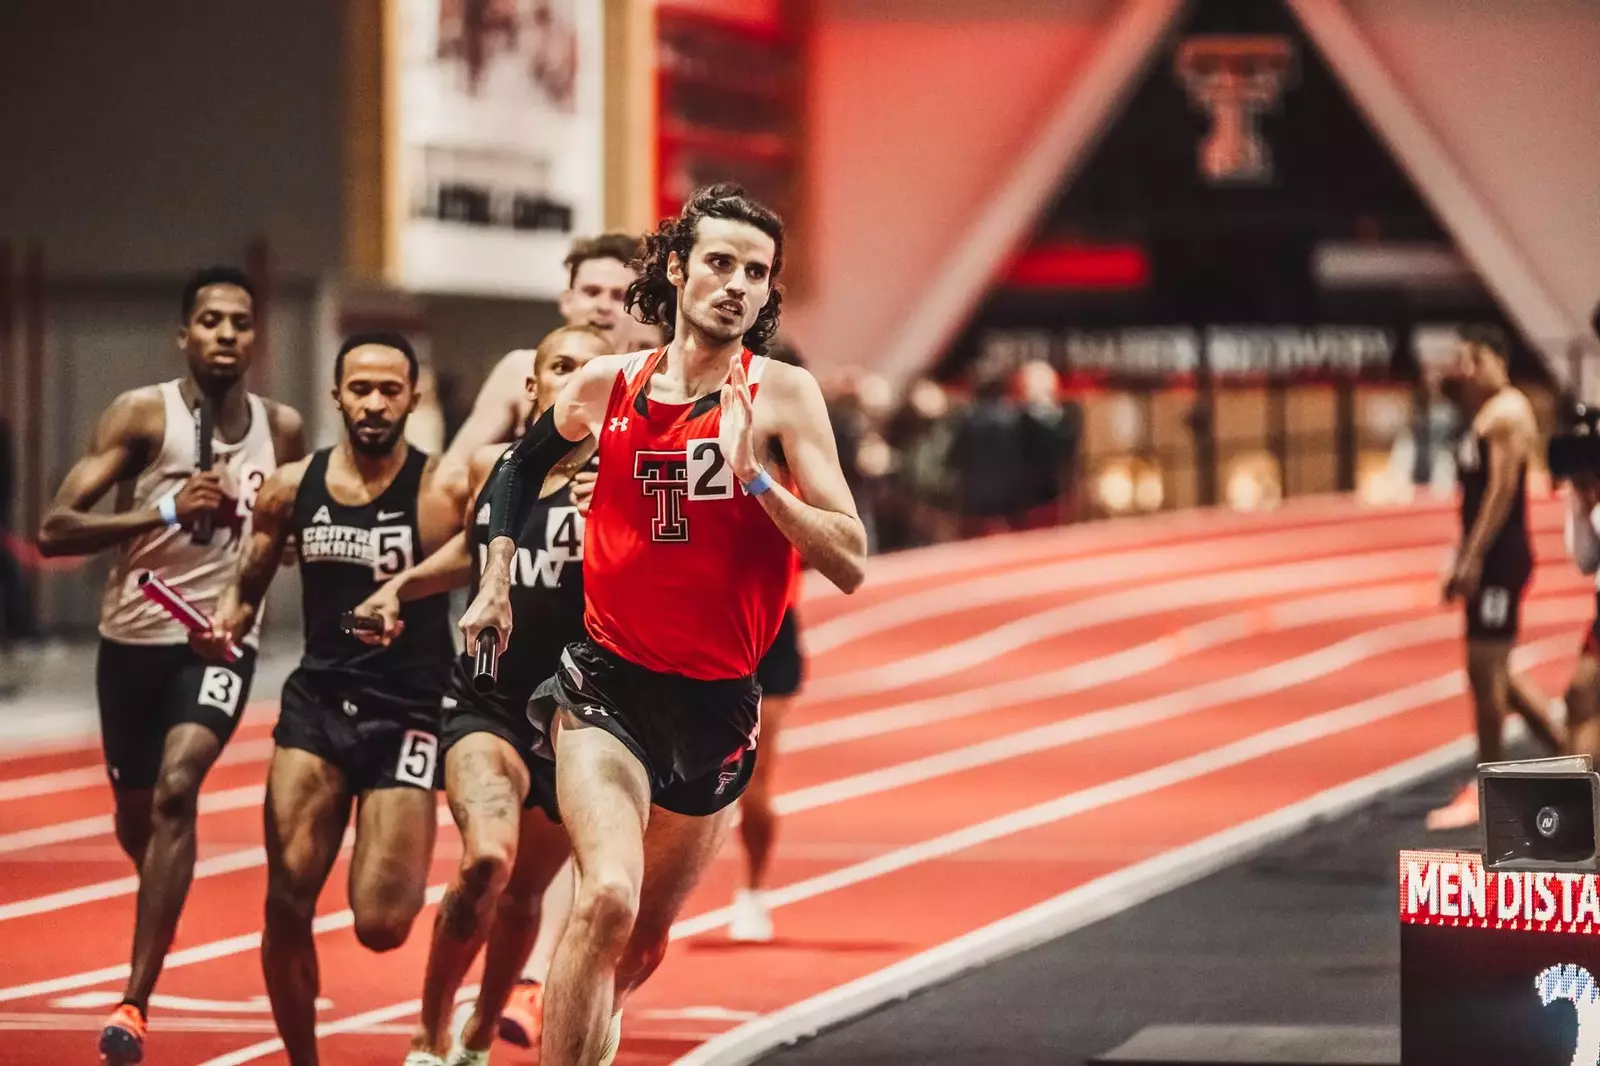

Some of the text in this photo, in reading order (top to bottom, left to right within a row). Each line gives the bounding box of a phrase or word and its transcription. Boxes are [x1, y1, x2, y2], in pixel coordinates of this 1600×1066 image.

[693, 442, 727, 495] 2
[380, 531, 405, 574] 5
[553, 512, 582, 557] 4
[208, 671, 233, 703] 3
[405, 735, 431, 778] 5
[1407, 861, 1600, 924] MEN DISTA
